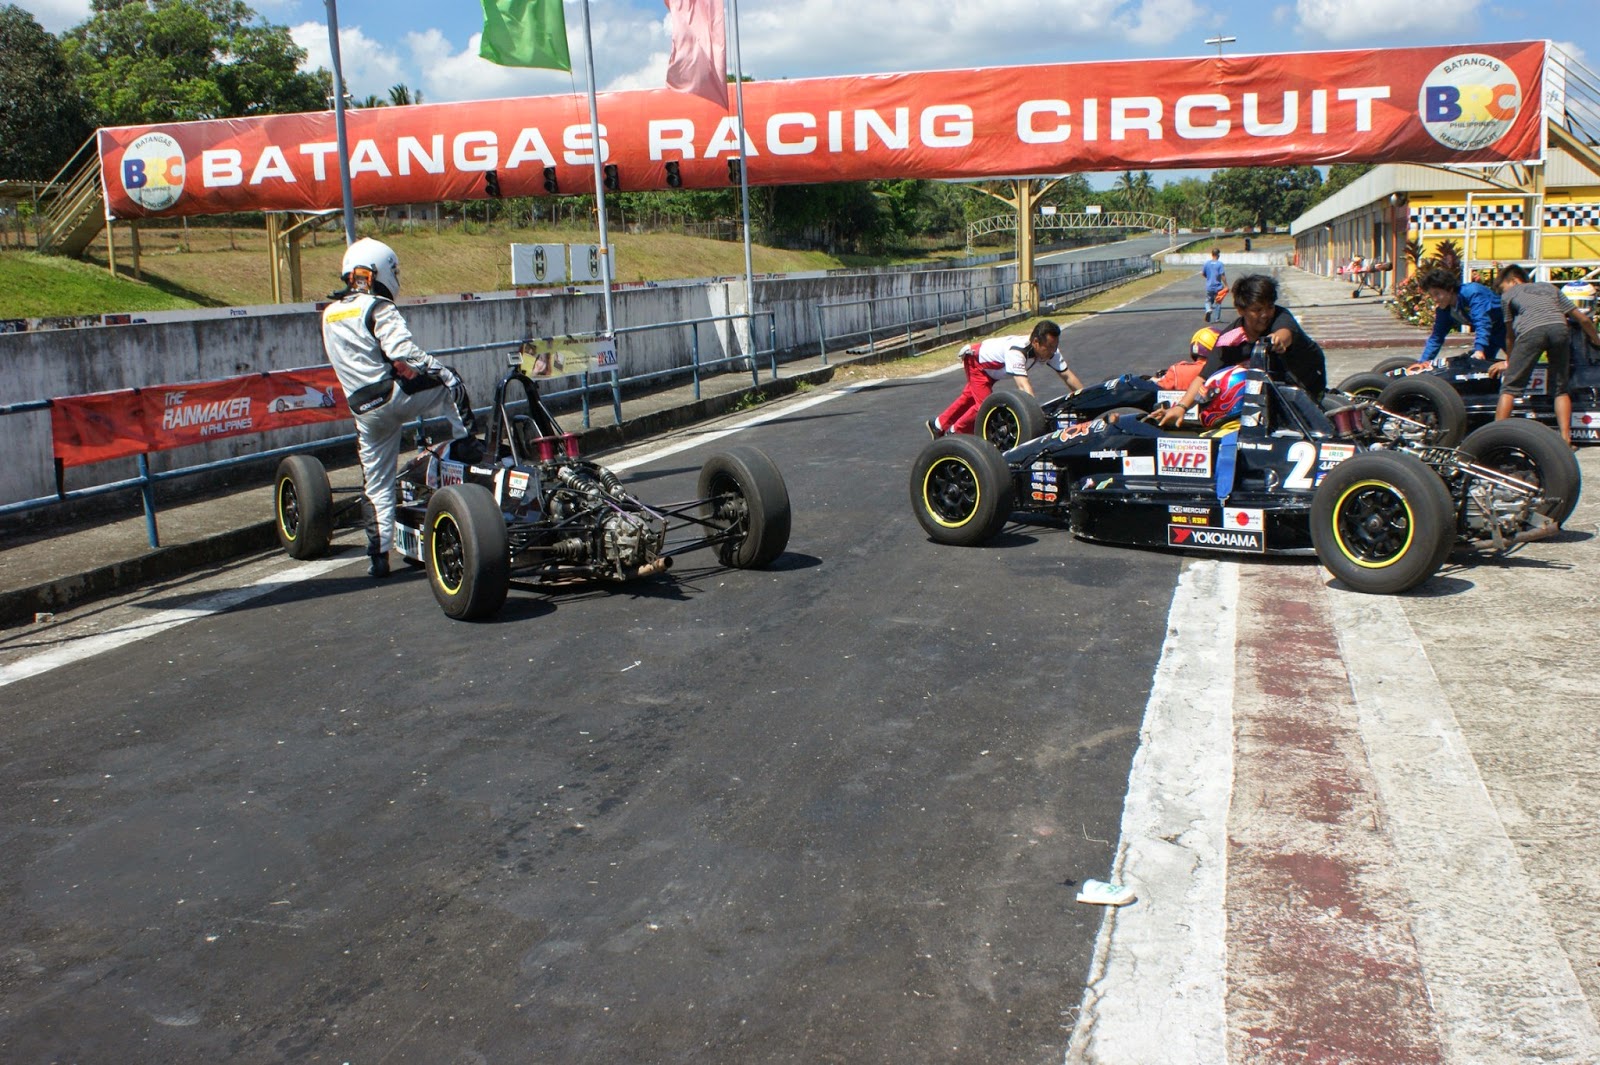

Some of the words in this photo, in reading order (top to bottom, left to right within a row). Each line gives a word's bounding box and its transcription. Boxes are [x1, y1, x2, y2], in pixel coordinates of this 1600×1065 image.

[1443, 58, 1500, 74] BATANGAS
[1425, 83, 1516, 123] BRC
[135, 136, 172, 149] BATANGAS
[203, 122, 609, 187] BATANGAS
[649, 104, 974, 161] RACING
[1017, 85, 1391, 144] CIRCUIT
[1440, 132, 1467, 147] RACING
[1469, 131, 1497, 147] CIRCUIT
[124, 155, 183, 190] BRC
[165, 390, 187, 406] THE
[162, 397, 250, 430] RAINMAKER
[209, 418, 252, 433] PHILIPPINES
[1159, 443, 1208, 451] Philippines
[1162, 451, 1207, 468] WFP
[1283, 441, 1316, 489] 2
[1192, 530, 1258, 548] YOKOHAMA
